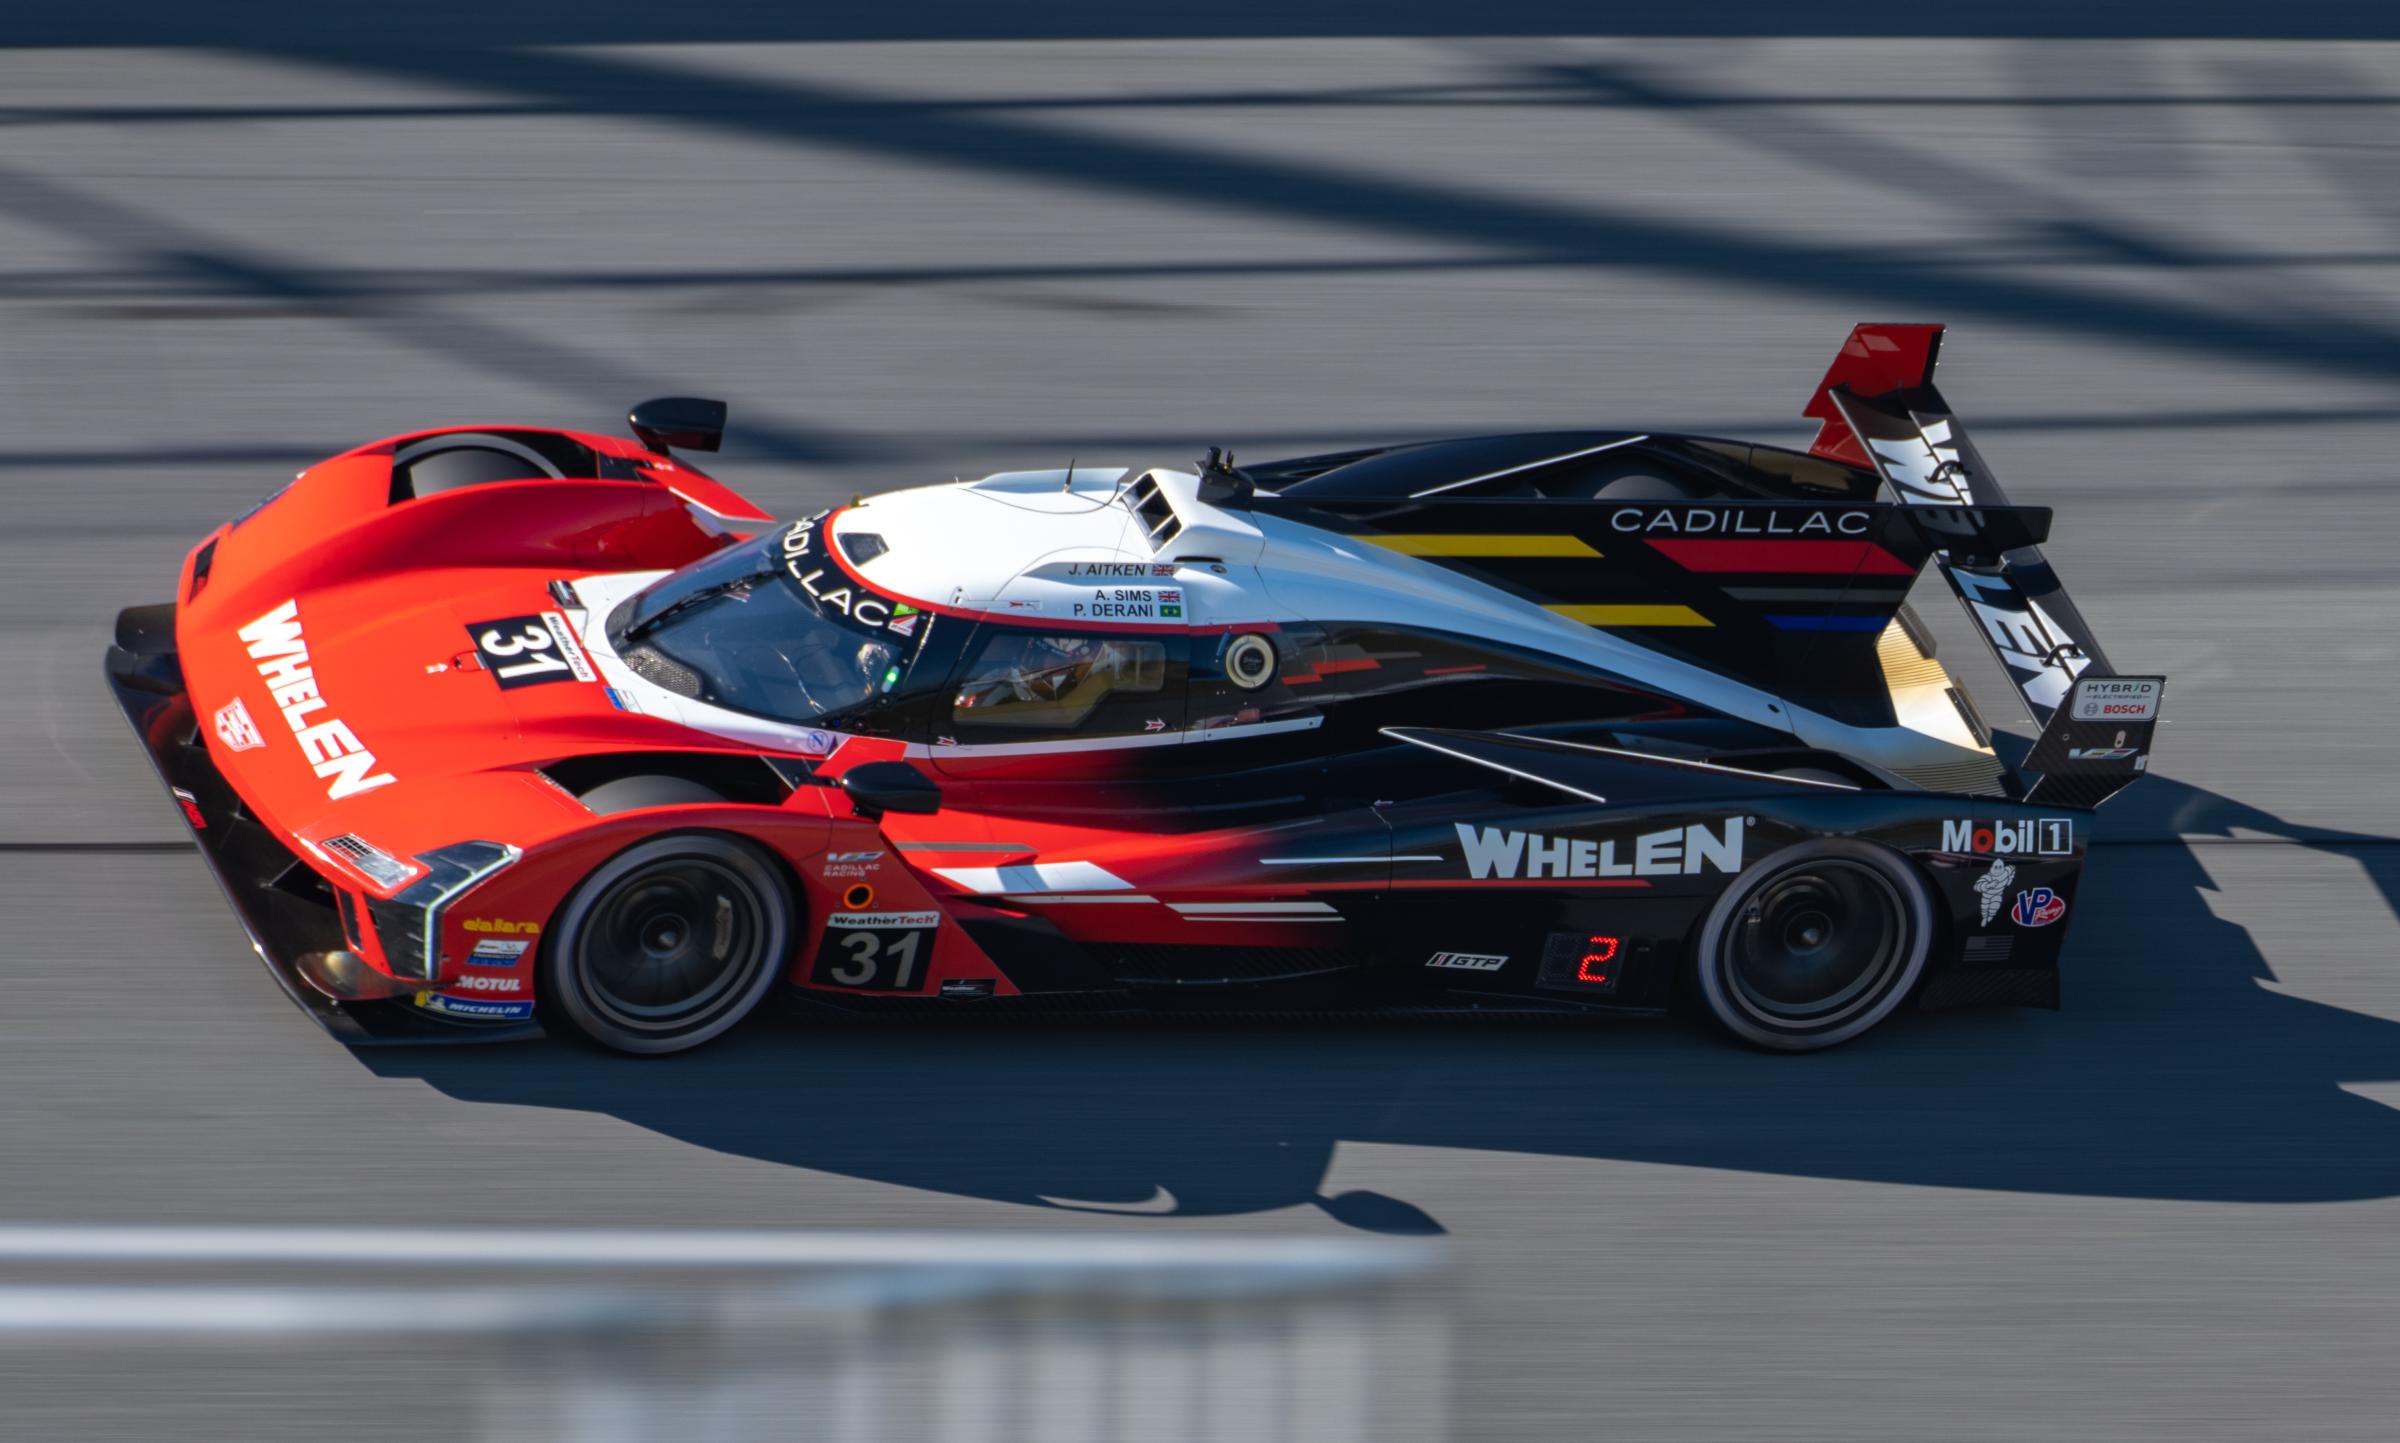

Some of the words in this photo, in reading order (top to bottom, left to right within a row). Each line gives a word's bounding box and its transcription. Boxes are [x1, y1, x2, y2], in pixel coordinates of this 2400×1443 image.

[1611, 508, 1870, 535] CADILLAC
[1068, 563, 1081, 576] J.
[1086, 564, 1146, 576] AITKEN
[1867, 419, 2093, 709] WLEN
[1095, 589, 1110, 601] A.
[1115, 590, 1152, 601] SIMS
[1073, 603, 1086, 617] P.
[1092, 604, 1154, 617] DERANI
[480, 625, 570, 679] 31
[548, 615, 590, 679] WeatherTech
[236, 598, 399, 801] WHELEN
[2103, 704, 2146, 714] BOSCH
[1941, 819, 2034, 853] Mobil
[833, 913, 936, 926] WeatherTech
[2017, 887, 2054, 926] VP
[830, 930, 921, 988] 31
[1452, 956, 1502, 967] GTP
[1576, 936, 1619, 982] 2
[456, 975, 521, 992] MOTUL
[448, 1002, 523, 1014] MICHELIN
